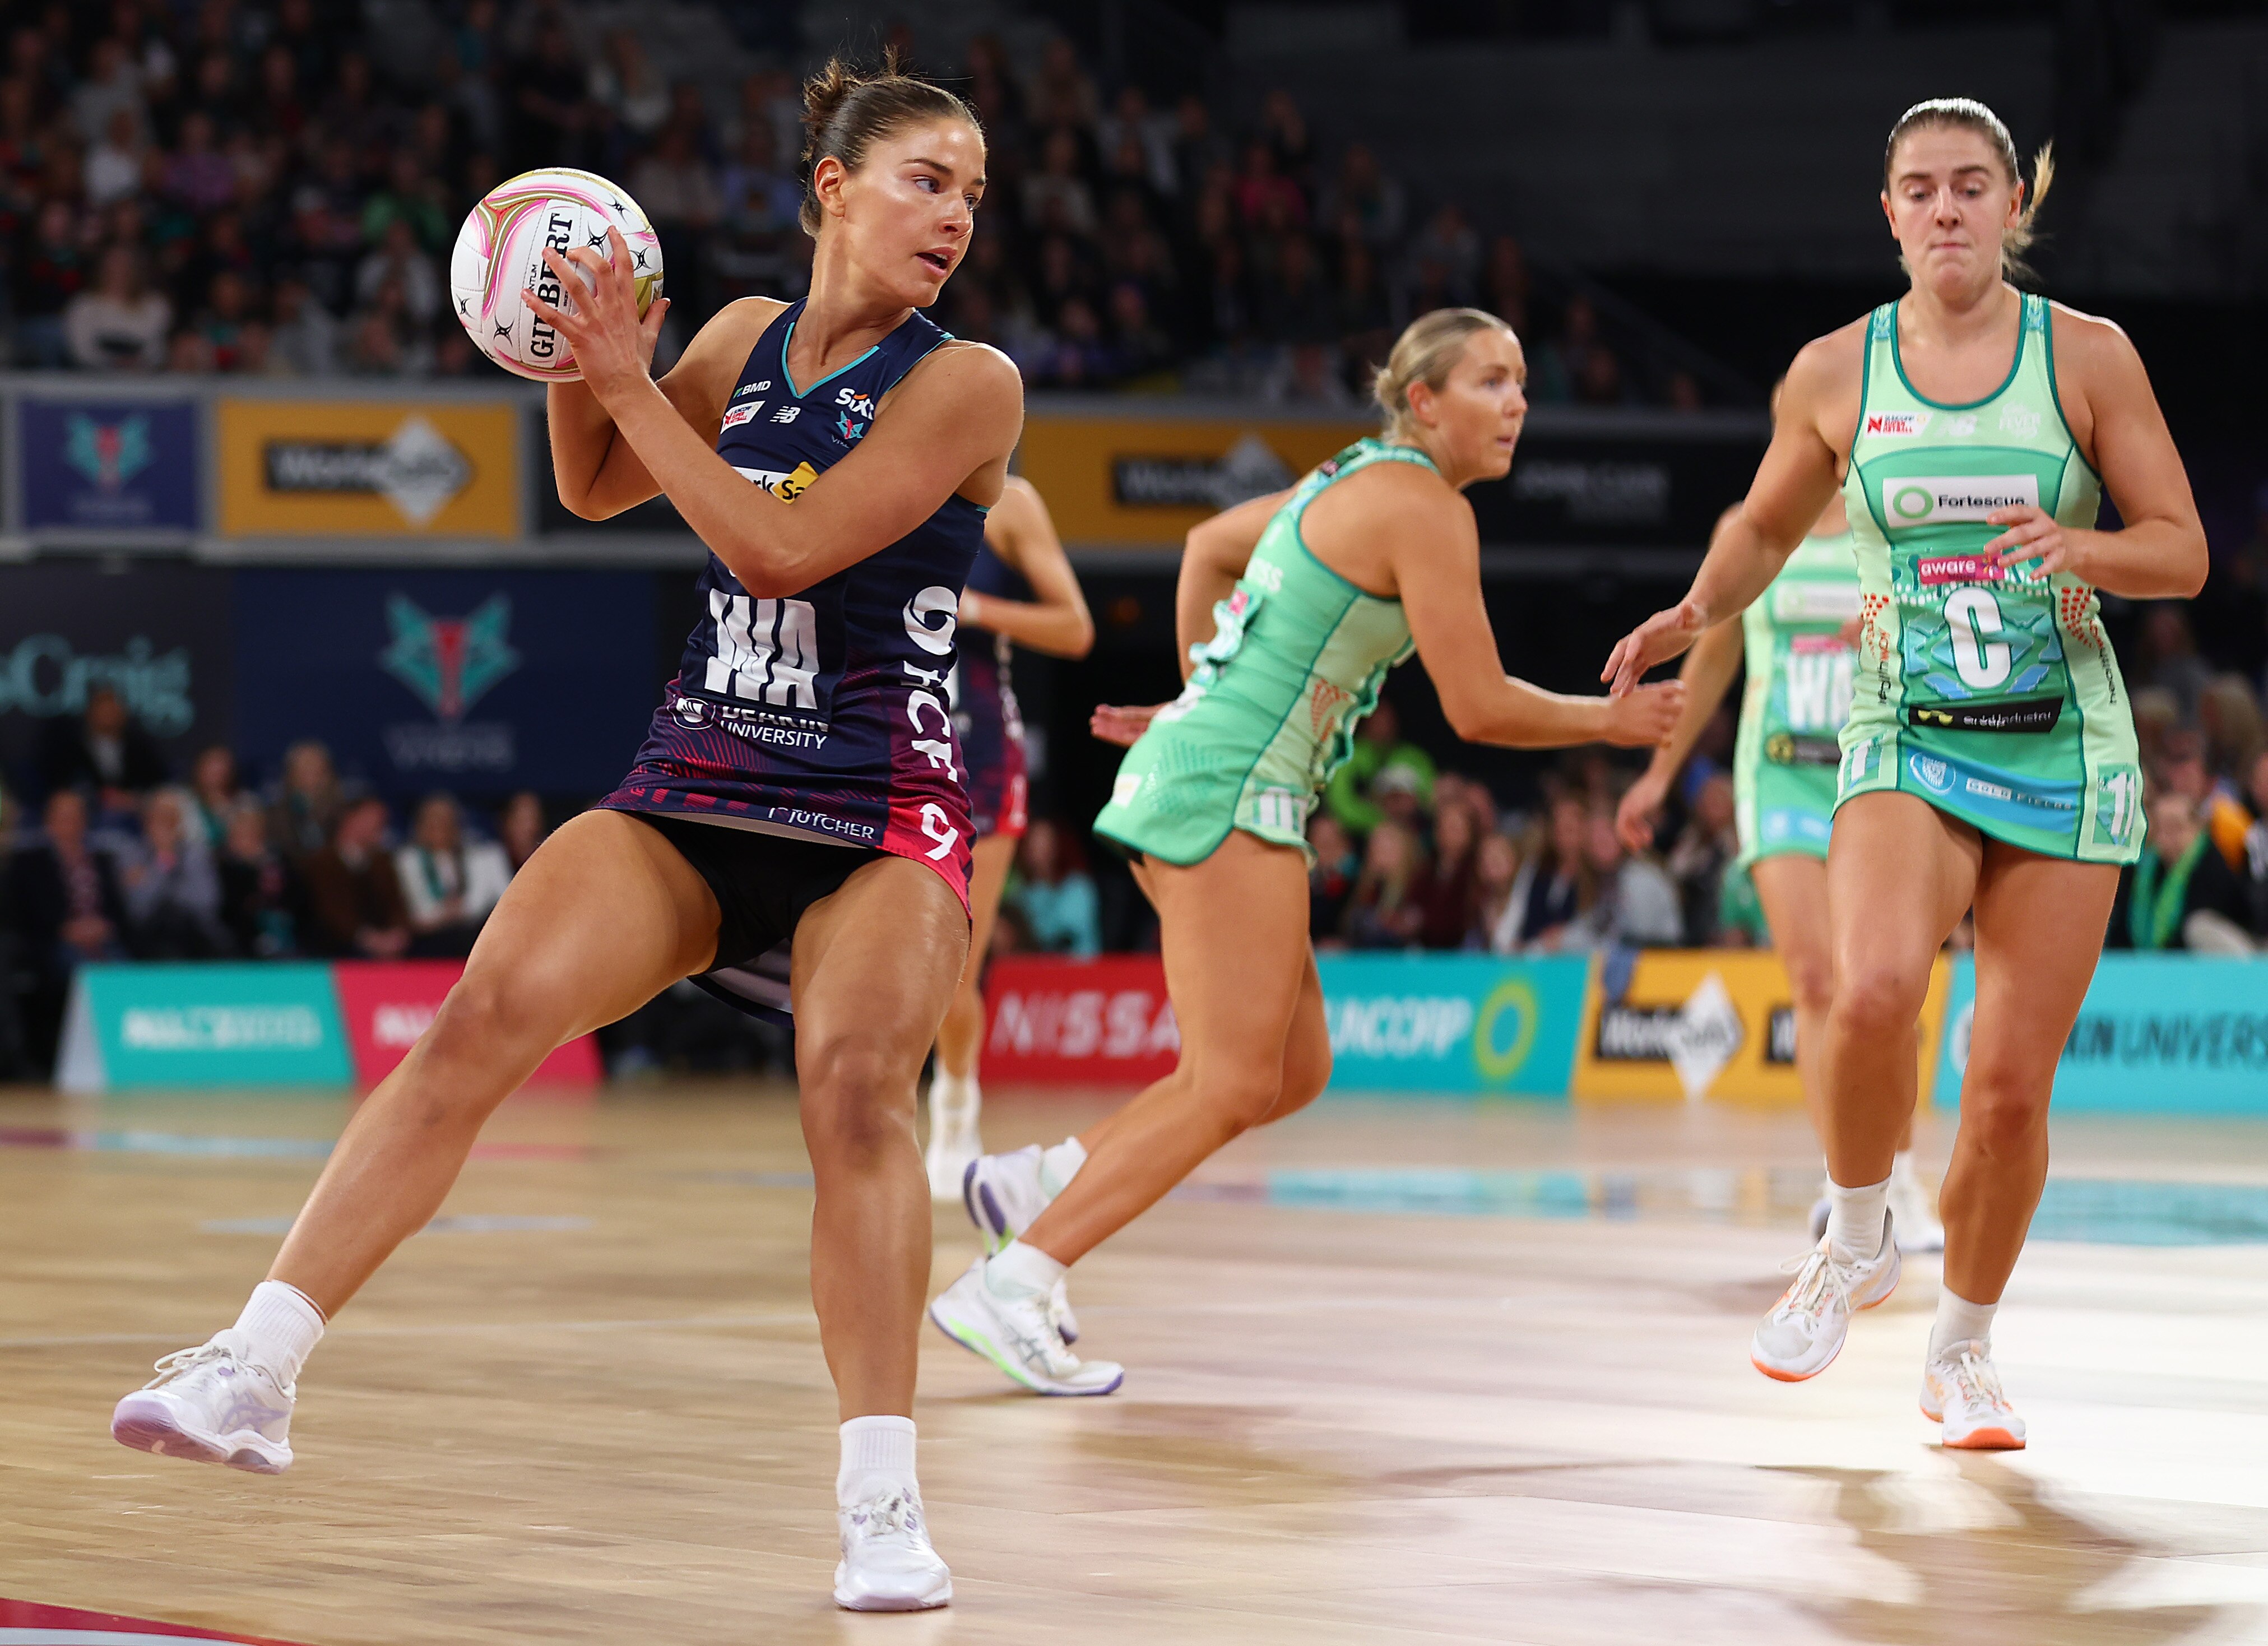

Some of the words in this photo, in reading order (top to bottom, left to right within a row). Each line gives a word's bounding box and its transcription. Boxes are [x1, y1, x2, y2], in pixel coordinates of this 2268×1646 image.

[741, 381, 772, 396] BMD
[1921, 559, 1976, 578] aware
[704, 587, 820, 710] WA
[1942, 585, 2014, 690] C
[720, 720, 828, 750] UNIVERSITY
[919, 802, 959, 861] 9
[989, 990, 1181, 1058] NISSA
[1324, 996, 1474, 1060] UNCORP
